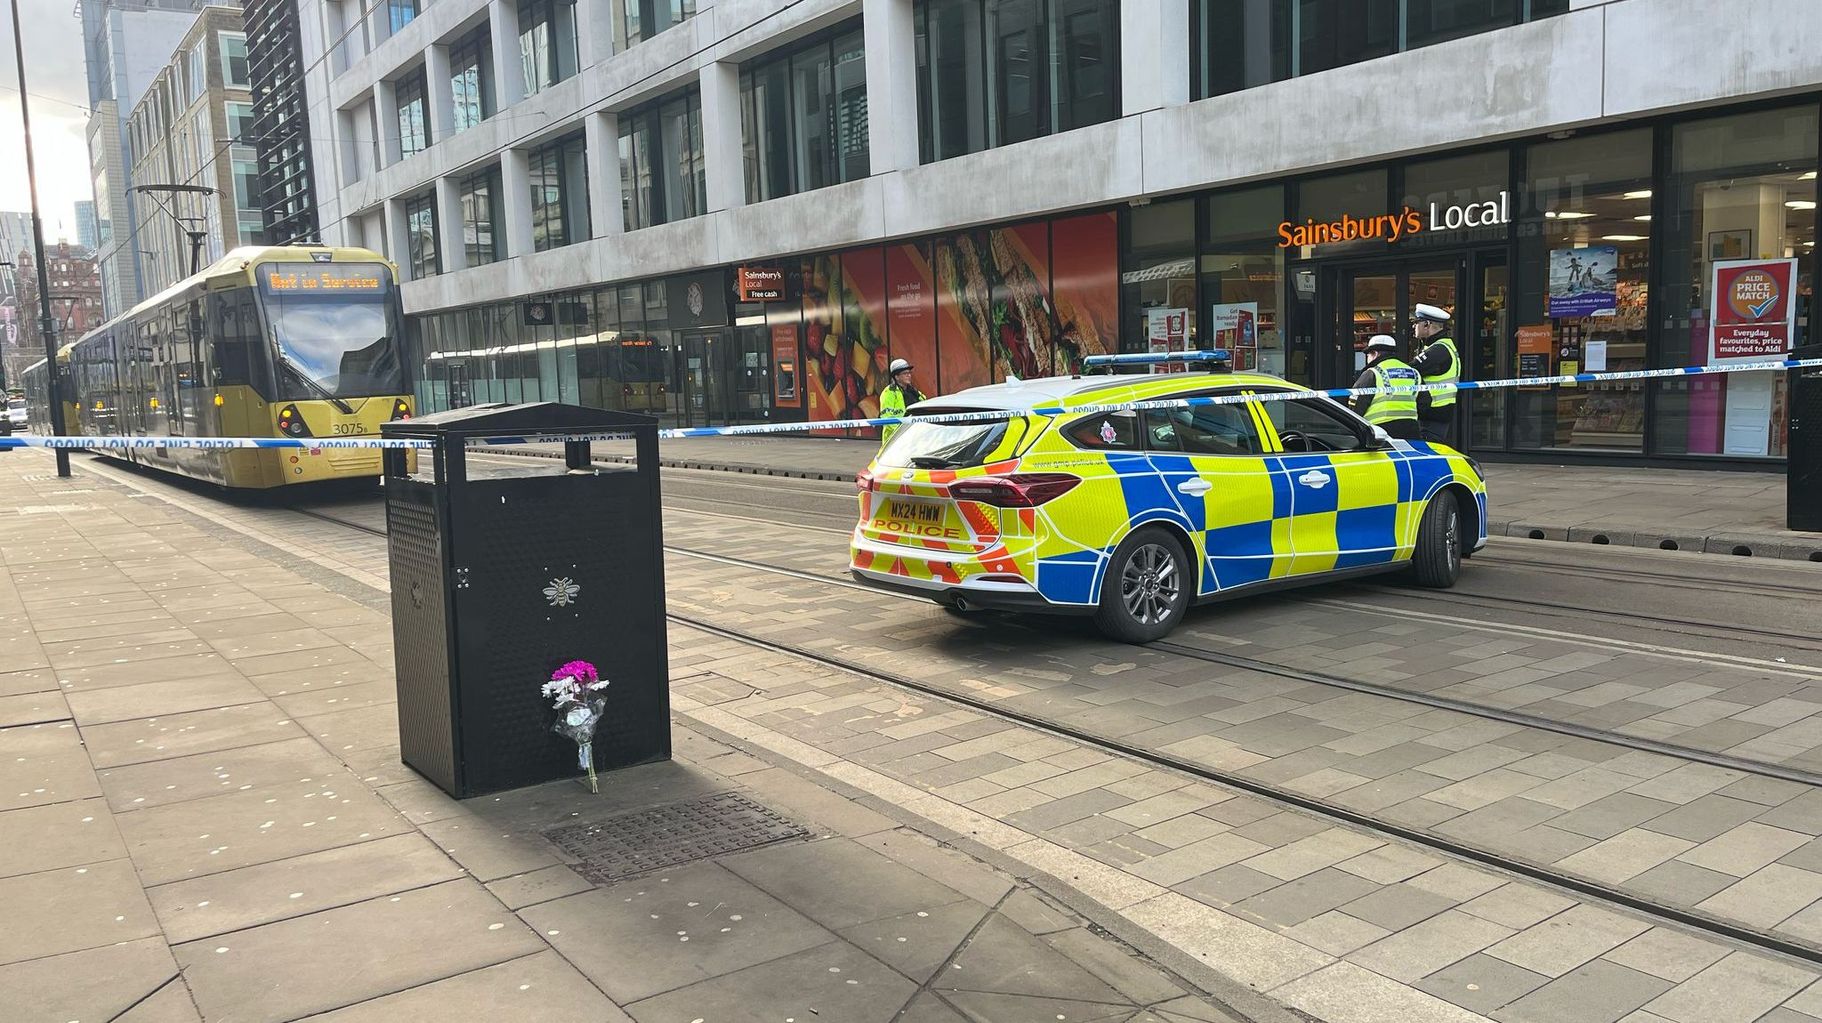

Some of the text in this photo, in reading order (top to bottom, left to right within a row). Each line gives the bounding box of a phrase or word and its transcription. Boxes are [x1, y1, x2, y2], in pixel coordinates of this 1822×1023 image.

[1277, 191, 1510, 248] Sainsbury's Local
[745, 271, 782, 280] Sainsbury's
[270, 273, 298, 289] Not
[321, 273, 379, 288] Service
[745, 280, 762, 288] Local
[1736, 283, 1770, 291] PRICE
[1736, 291, 1770, 300] MATCH
[1762, 338, 1782, 346] price
[1765, 345, 1781, 353] Aldi
[891, 502, 940, 522] MX24 HWW
[874, 519, 961, 538] POLICE
